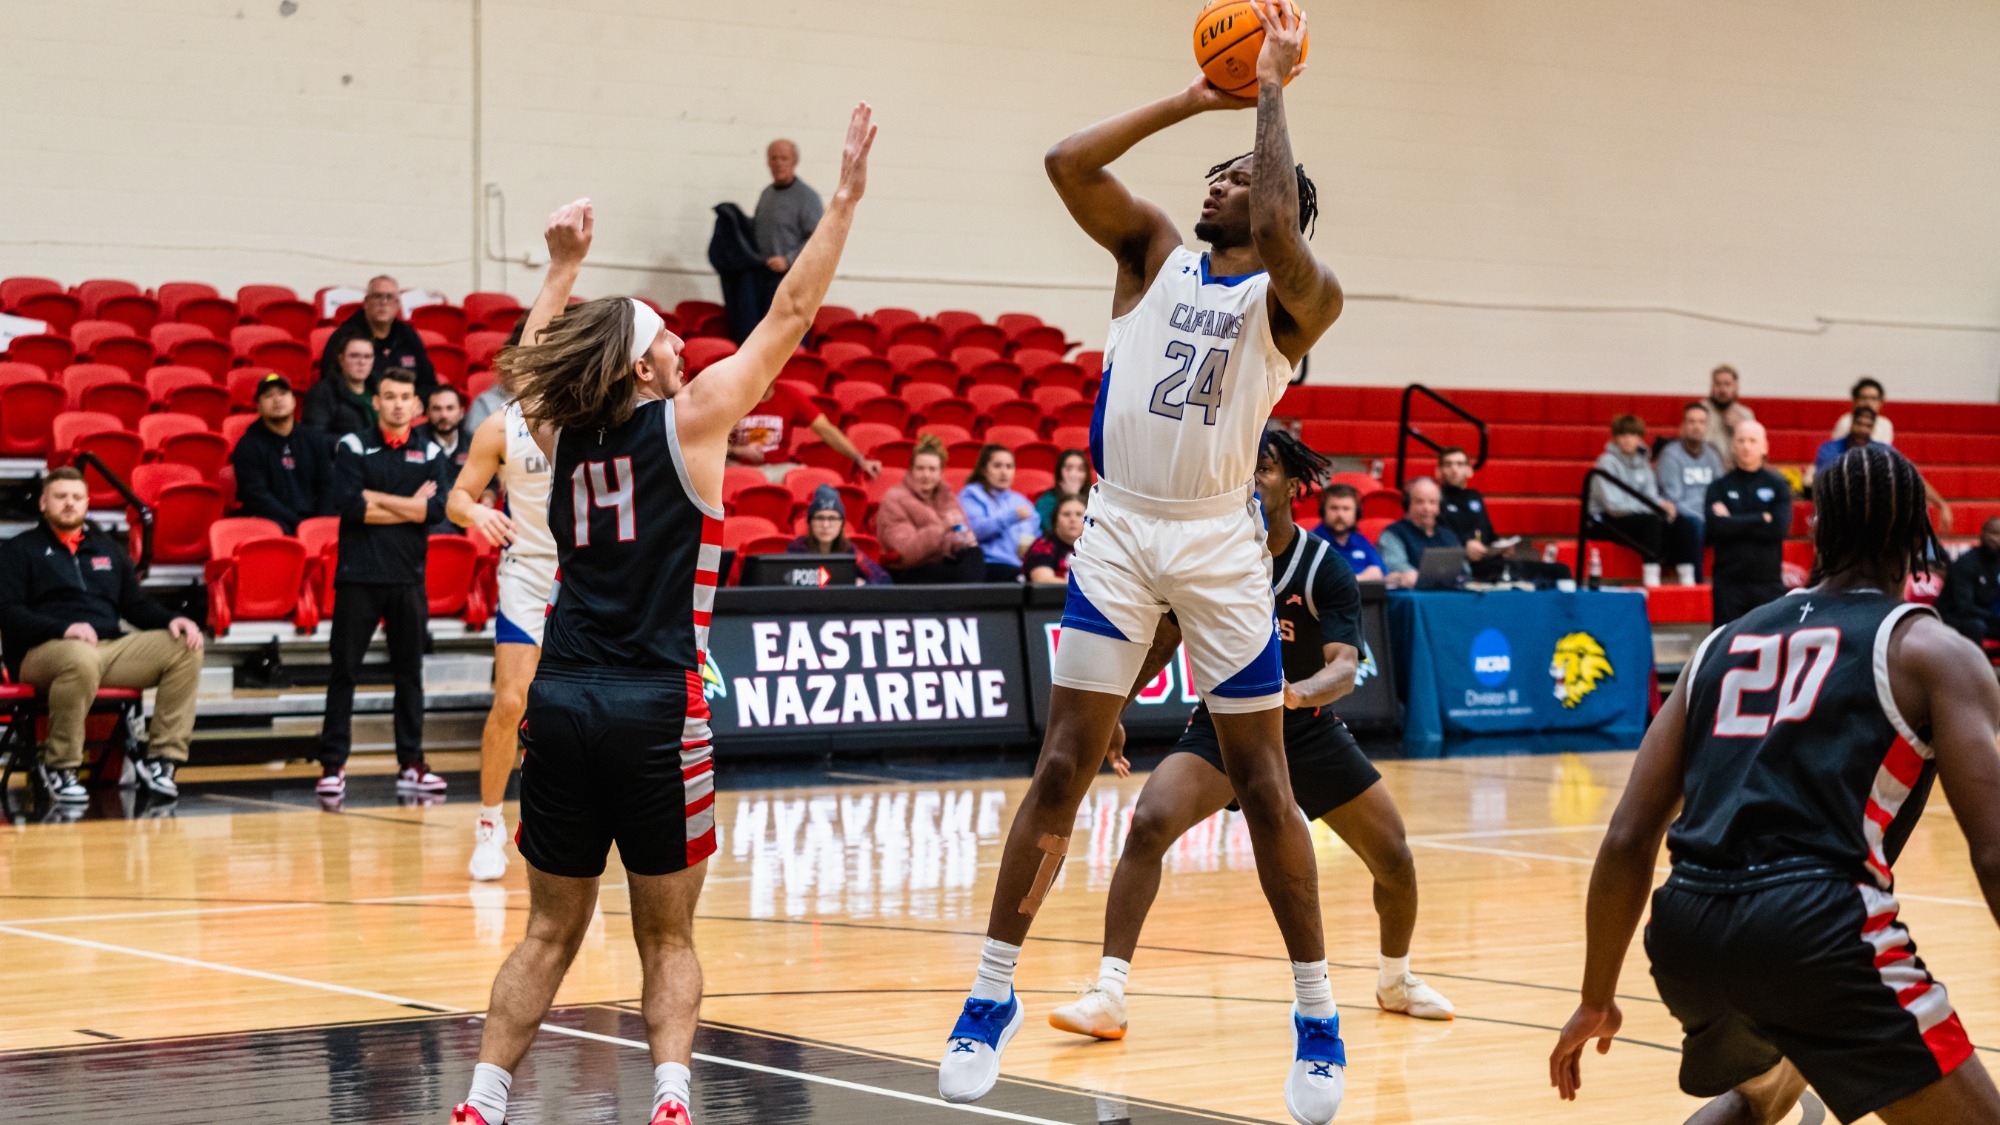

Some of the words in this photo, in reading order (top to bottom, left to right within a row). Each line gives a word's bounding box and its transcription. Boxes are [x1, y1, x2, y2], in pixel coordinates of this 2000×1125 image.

[1148, 340, 1229, 426] 24
[571, 455, 637, 548] 14
[752, 617, 981, 672] EASTERN
[1712, 626, 1842, 738] 20
[733, 669, 1009, 728] NAZARENE
